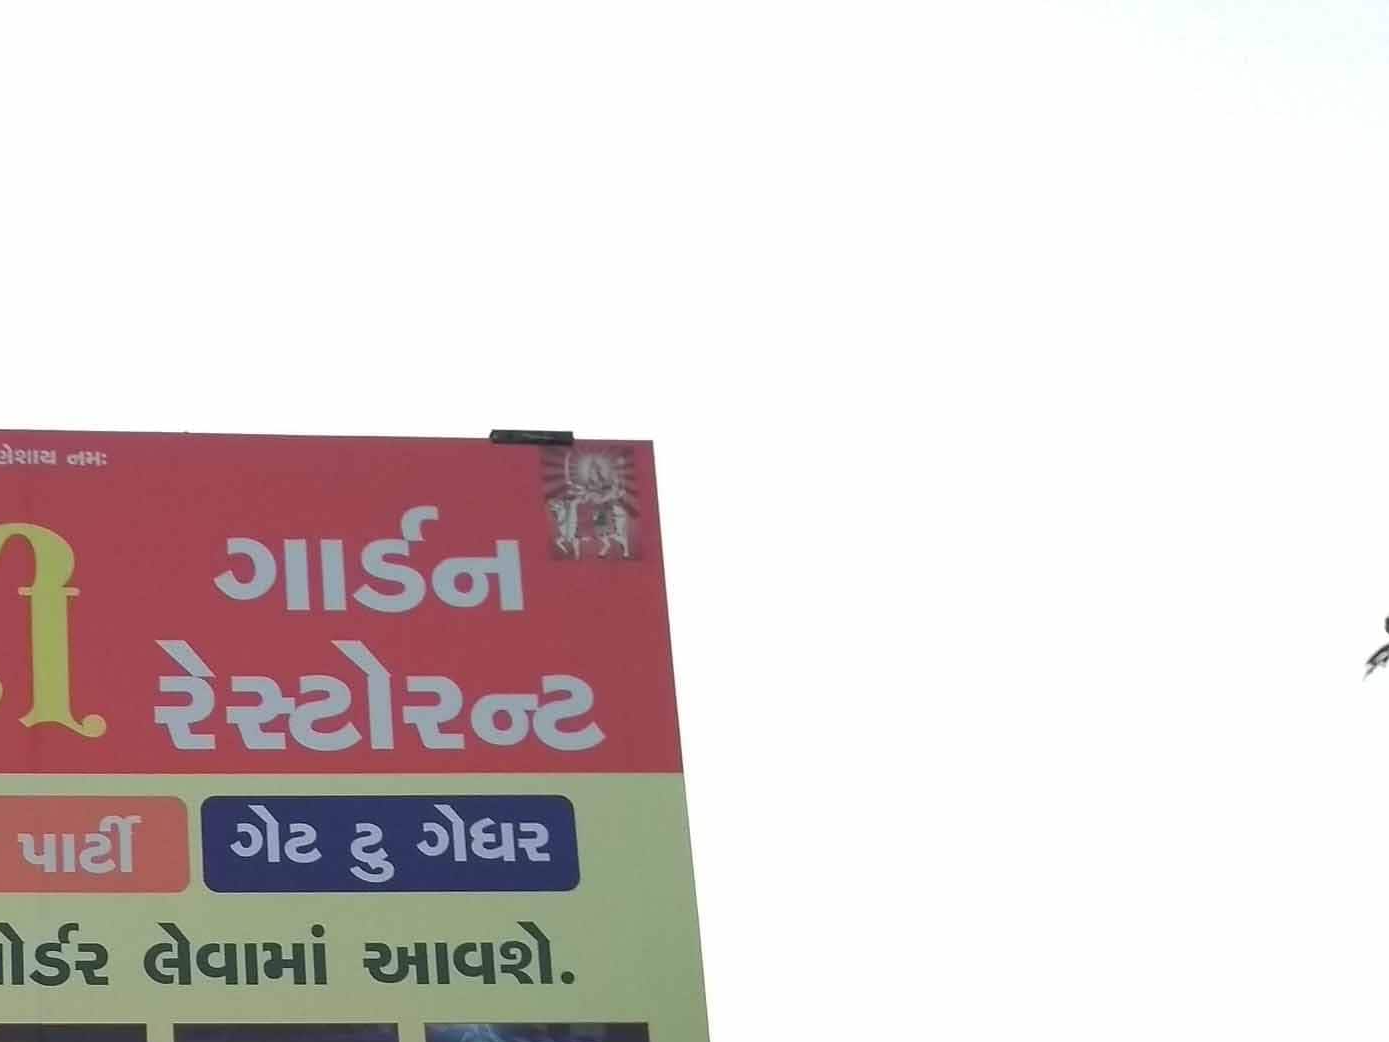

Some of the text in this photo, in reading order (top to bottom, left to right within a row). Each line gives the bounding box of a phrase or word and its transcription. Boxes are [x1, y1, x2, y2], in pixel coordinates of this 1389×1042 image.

[212, 505, 526, 614] ગાર્ડન
[153, 638, 606, 752] રેસ્ટોરન્ટ
[17, 815, 145, 875] પાર્ટી
[229, 803, 552, 884] ગેટ ટુ ગેધર
[142, 922, 328, 986] લેવામાં
[362, 920, 576, 986] આવશે.
